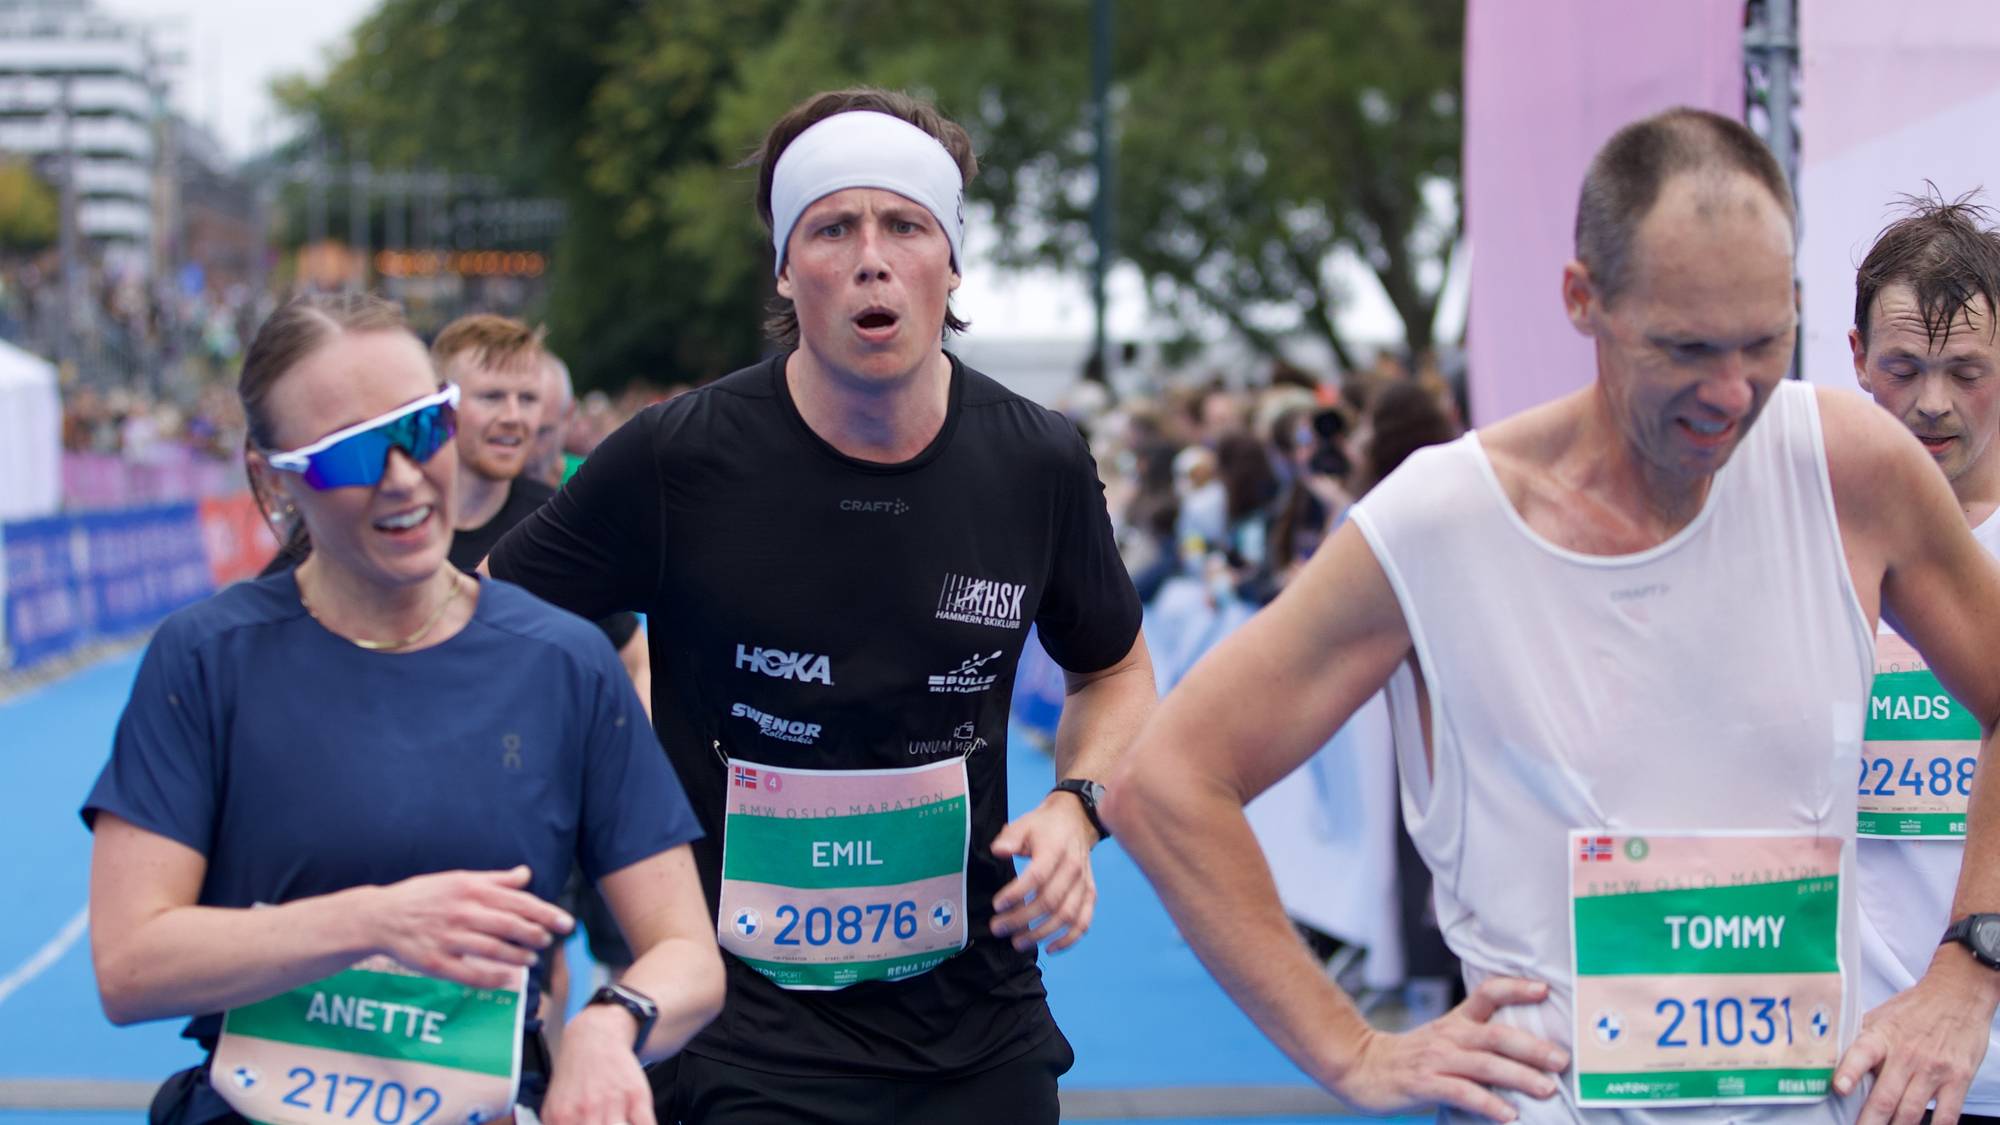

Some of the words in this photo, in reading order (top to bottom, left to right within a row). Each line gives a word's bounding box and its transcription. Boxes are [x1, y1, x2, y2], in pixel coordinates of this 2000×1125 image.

[840, 499, 893, 513] CRAFT
[981, 580, 1026, 620] HSK
[935, 610, 982, 624] HAMMERN
[983, 616, 1021, 630] SKIKLUBB
[736, 643, 831, 686] HOKA
[731, 702, 822, 738] SWENOR
[1872, 695, 1950, 720] MADS
[769, 777, 777, 788] 4
[739, 804, 776, 817] BMW
[786, 806, 837, 820] OSLO
[850, 792, 944, 816] MARATON
[812, 841, 883, 867] EMIL
[1631, 843, 1641, 855] 6
[774, 900, 918, 946] 20876
[1664, 914, 1786, 950] TOMMY
[887, 962, 919, 977] REMA
[306, 991, 447, 1044] ANETTE
[1654, 996, 1793, 1048] 21031
[282, 1067, 442, 1125] 21702
